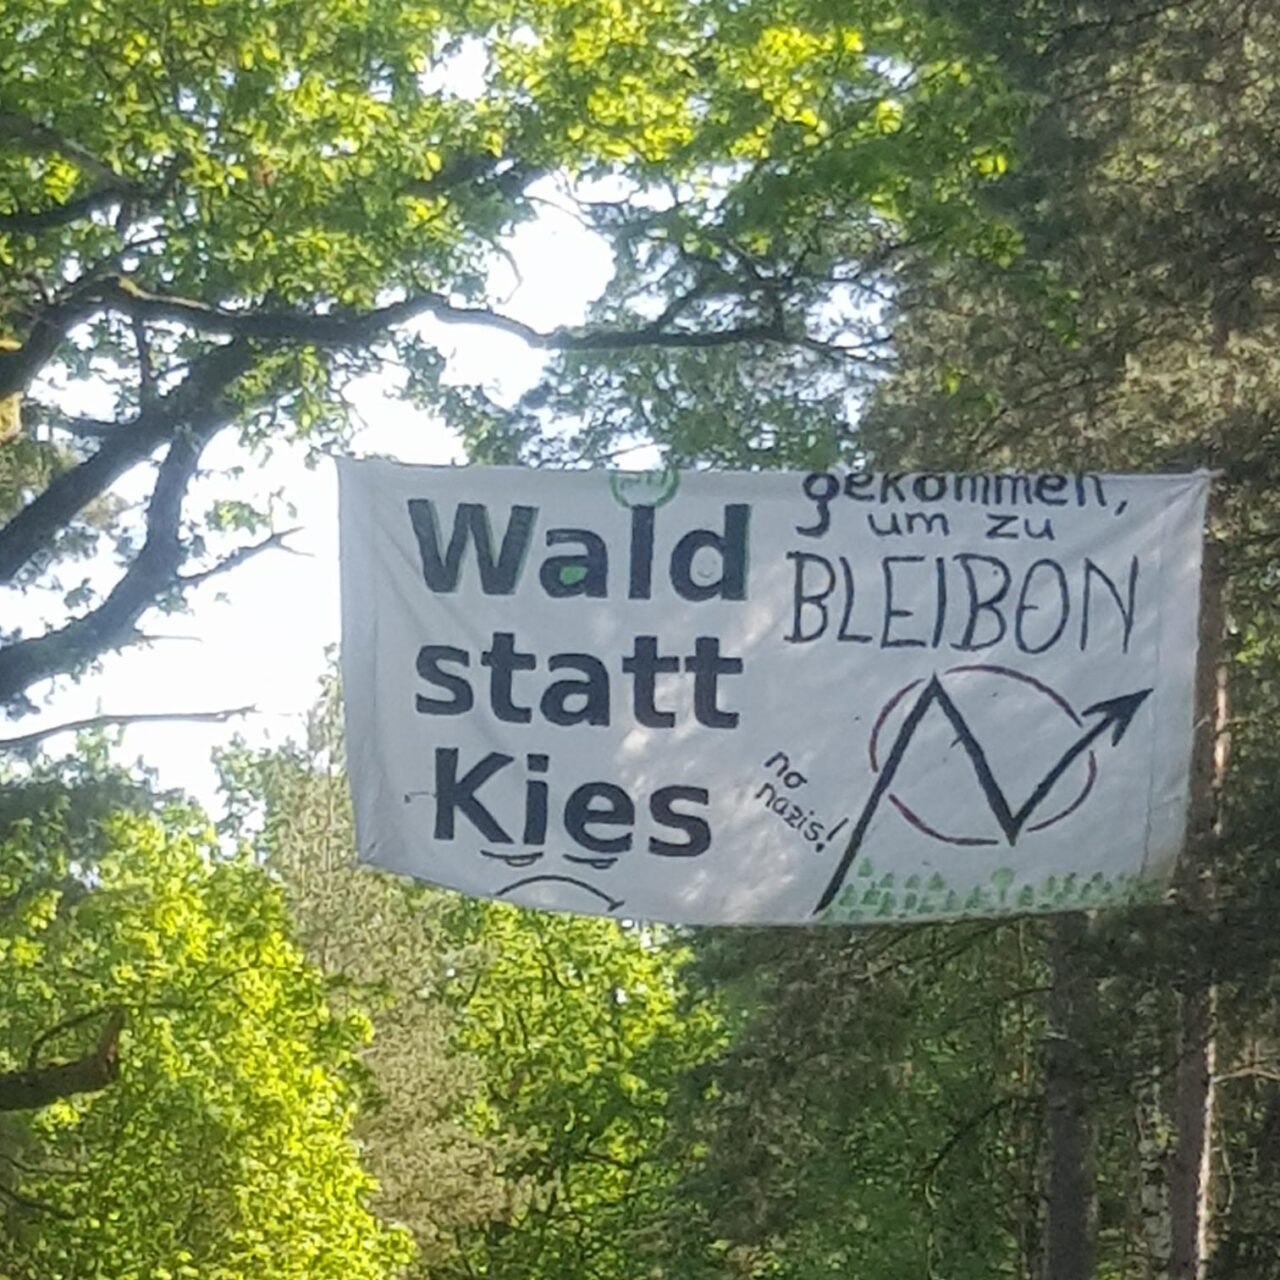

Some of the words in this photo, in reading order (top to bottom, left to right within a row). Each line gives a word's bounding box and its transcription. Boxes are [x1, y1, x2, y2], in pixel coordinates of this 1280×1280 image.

[408, 498, 751, 602] Wald
[867, 511, 950, 538] um
[985, 513, 1056, 541] zu
[415, 631, 744, 729] statt
[433, 747, 713, 857] Kies
[764, 751, 808, 789] no
[754, 782, 849, 853] nazis!
